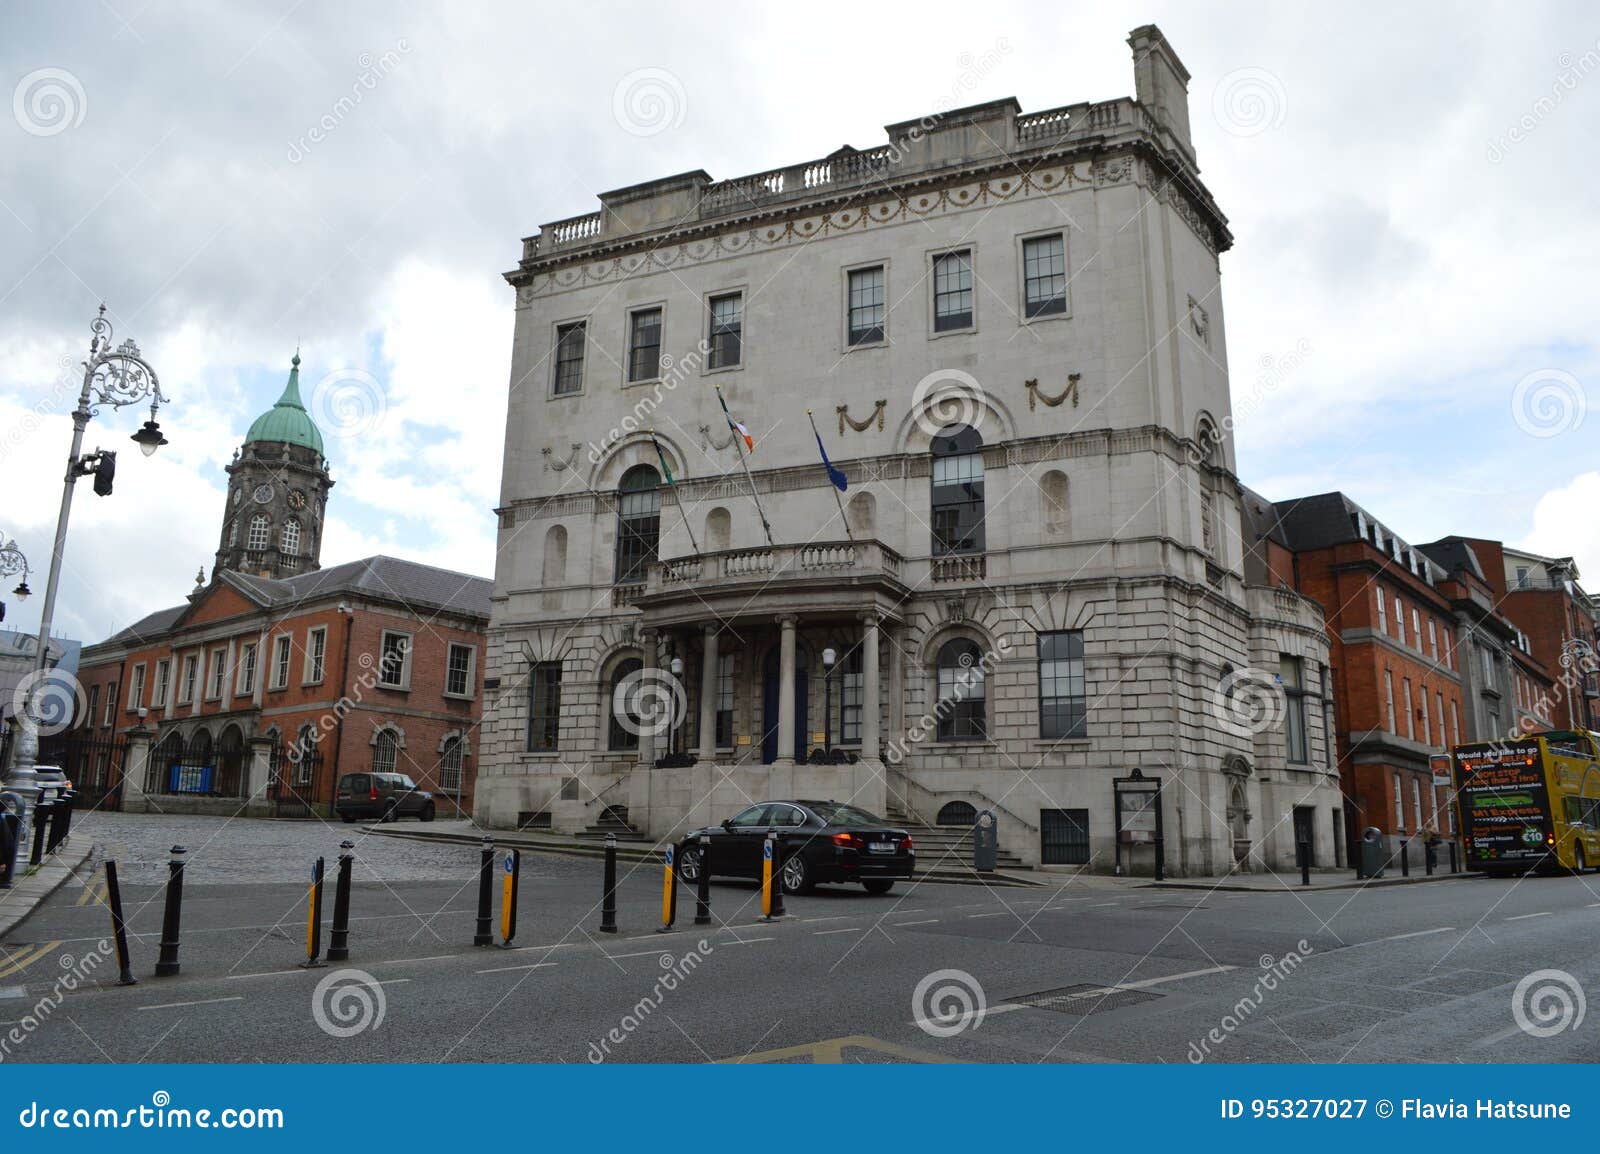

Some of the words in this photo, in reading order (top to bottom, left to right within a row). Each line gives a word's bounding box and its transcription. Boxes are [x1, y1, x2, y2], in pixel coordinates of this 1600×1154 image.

[1457, 750, 1481, 759] Would
[1483, 750, 1497, 759] you
[1527, 747, 1538, 755] go
[1522, 832, 1543, 842] €10
